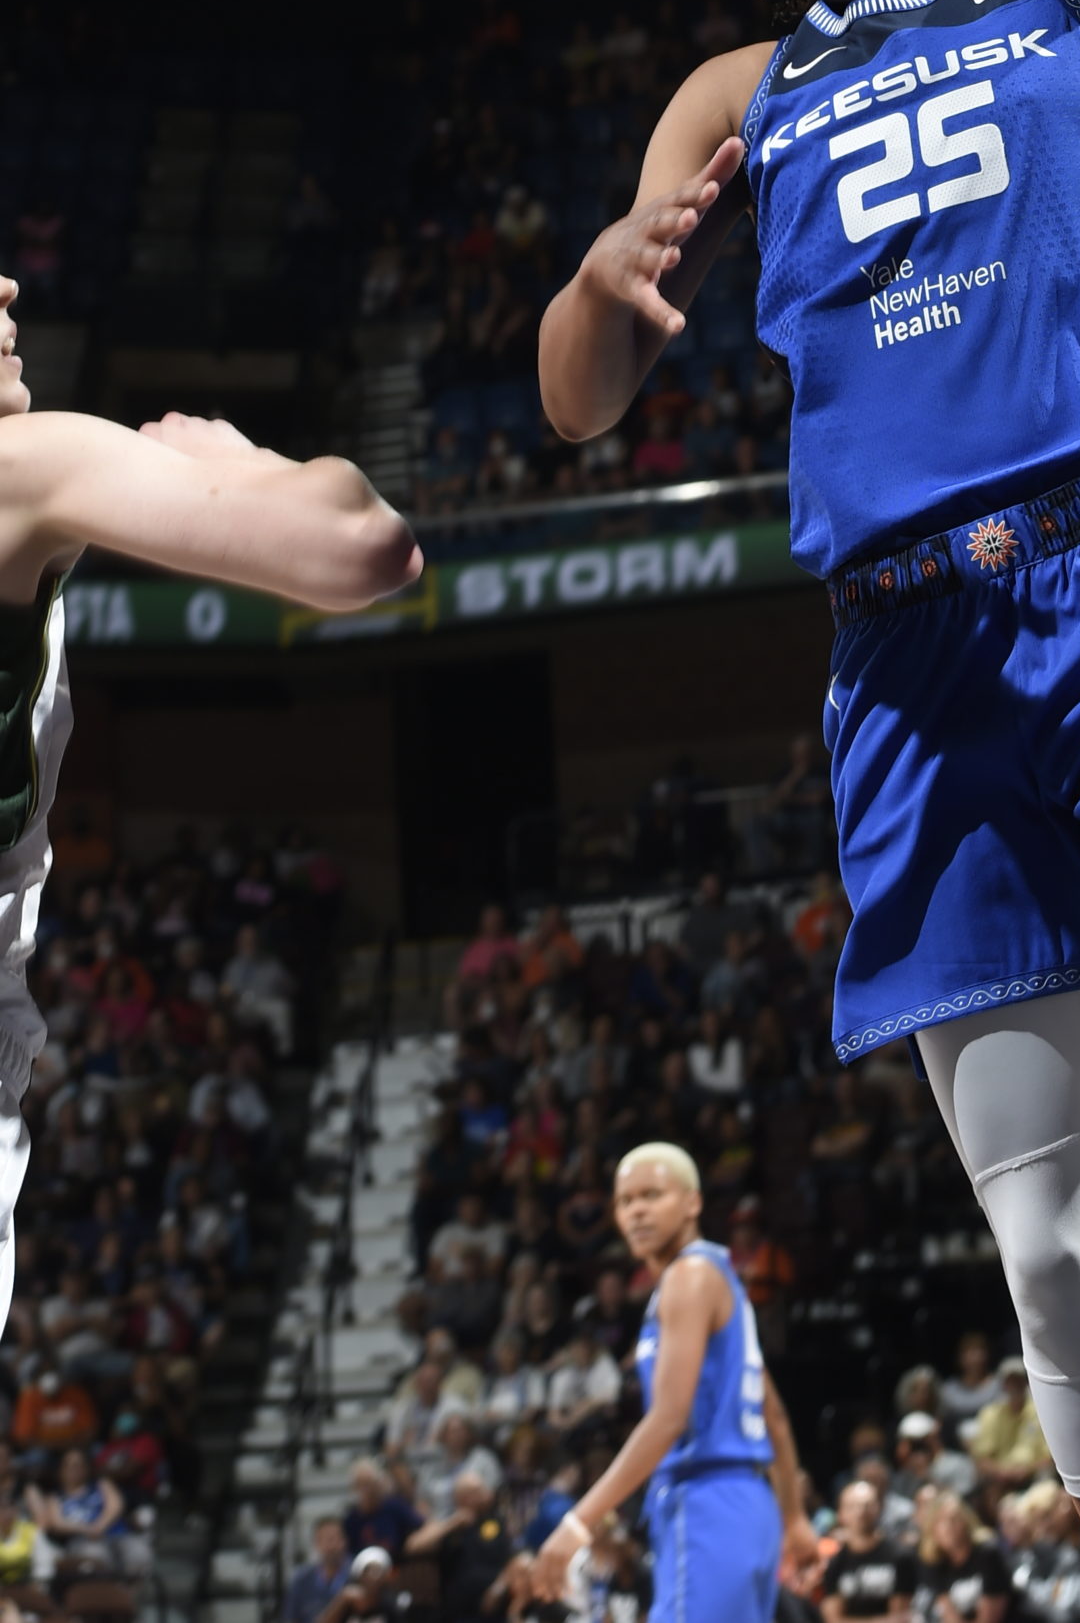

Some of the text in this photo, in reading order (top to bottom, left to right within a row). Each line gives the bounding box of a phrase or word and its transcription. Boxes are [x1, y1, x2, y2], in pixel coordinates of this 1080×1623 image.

[761, 29, 1057, 163] KEESUSK
[829, 80, 1010, 244] 25
[860, 257, 914, 289] Yale
[869, 260, 1006, 319] NewHaven
[873, 303, 961, 349] Health
[456, 534, 739, 615] STORM
